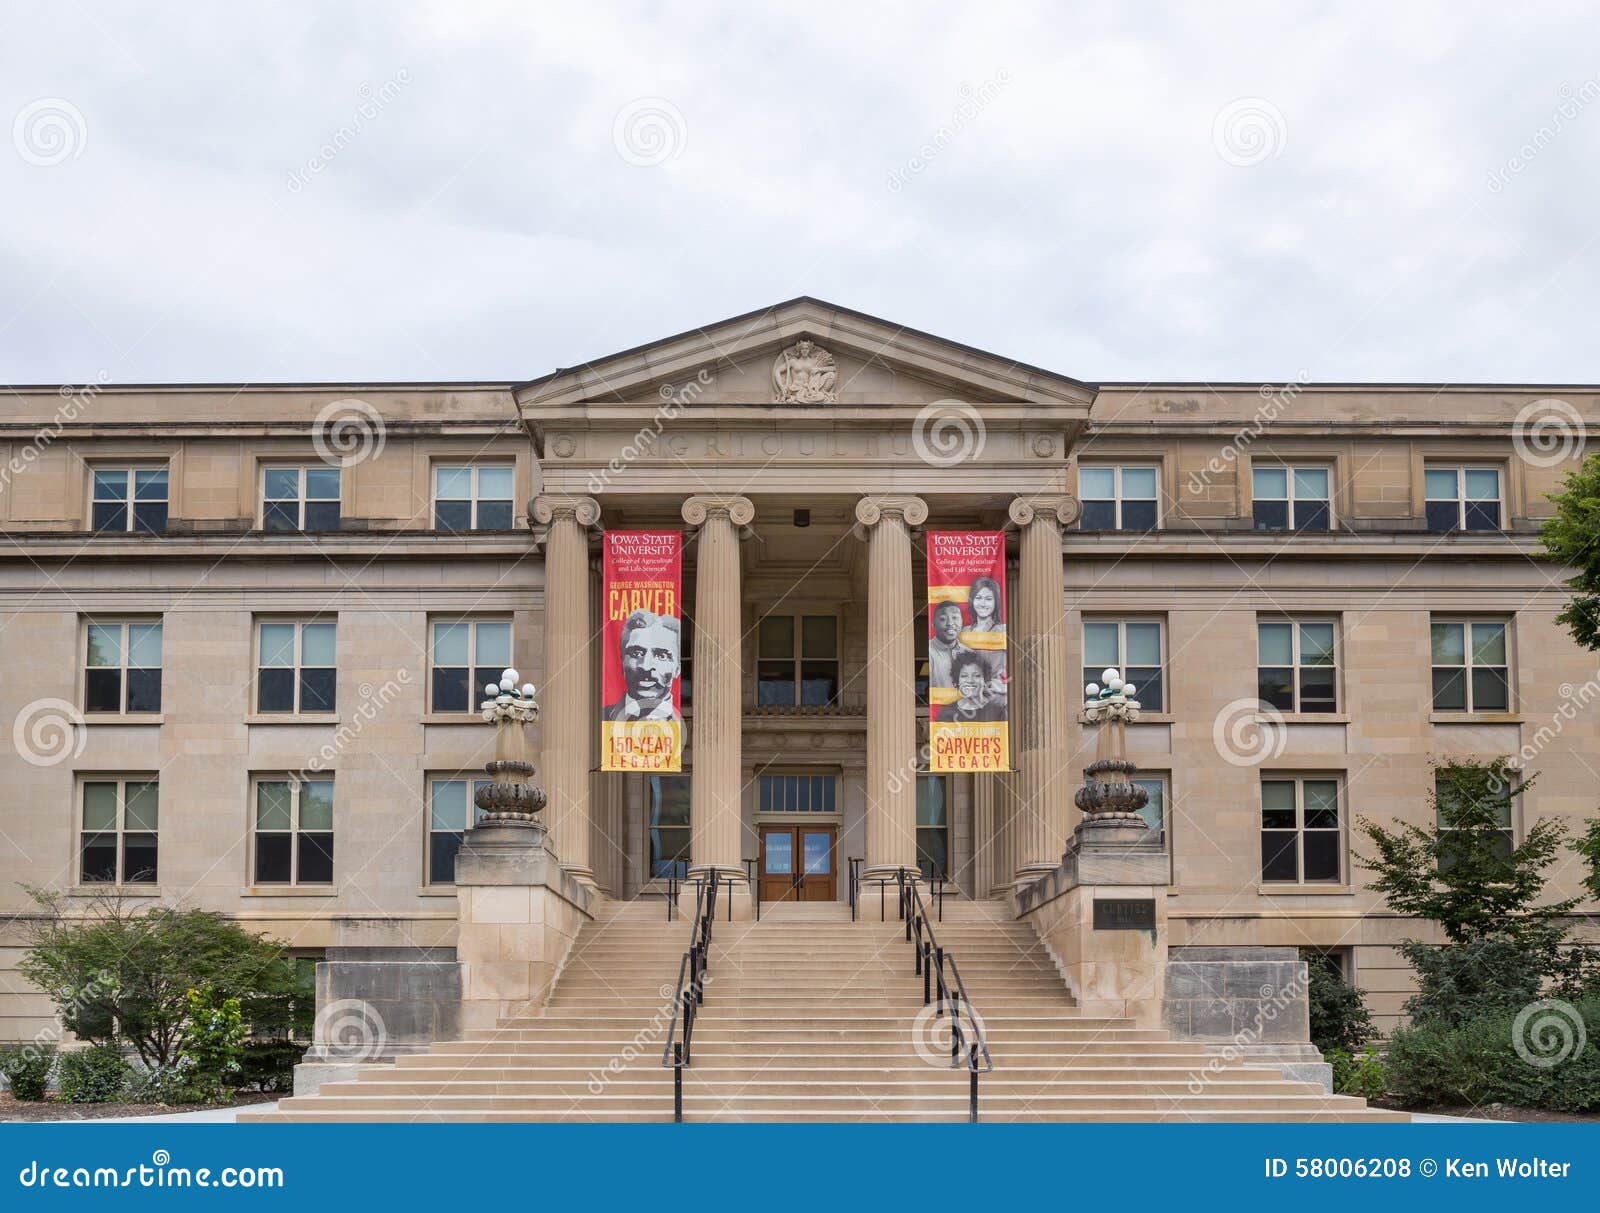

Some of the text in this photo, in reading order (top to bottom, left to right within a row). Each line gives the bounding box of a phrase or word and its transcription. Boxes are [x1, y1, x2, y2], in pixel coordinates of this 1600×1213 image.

[611, 534, 675, 545] IOWA STATE
[934, 534, 998, 545] IOWA STATE
[611, 545, 675, 555] UNIVERSITY
[935, 546, 998, 556] UNIVERSITY
[634, 581, 675, 589] WASHINGTON
[609, 590, 675, 621] CARVER
[609, 736, 673, 754] 150-YEAR
[936, 737, 1001, 754] CARVER'S
[610, 755, 672, 769] LEGACY
[937, 755, 1001, 769] LEGACY
